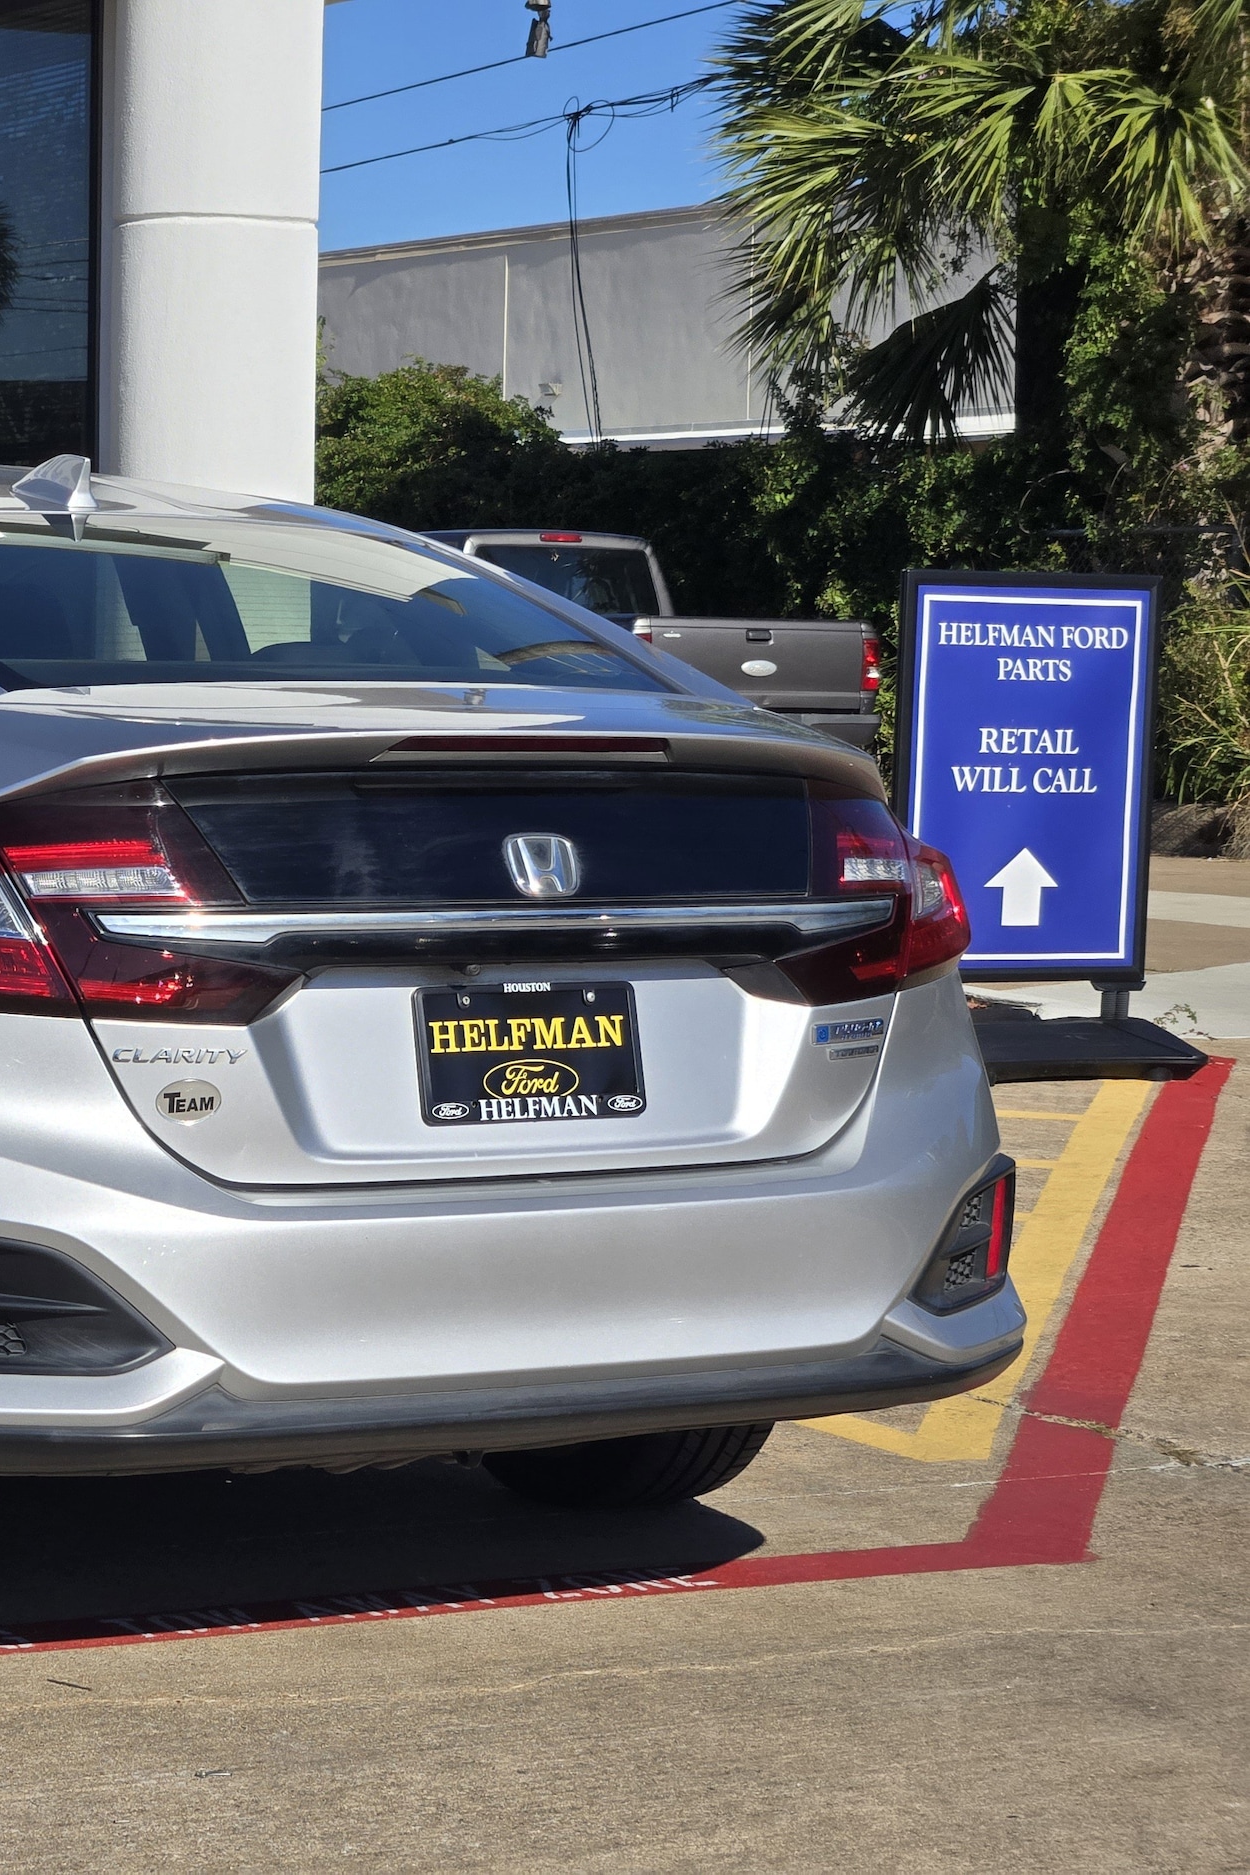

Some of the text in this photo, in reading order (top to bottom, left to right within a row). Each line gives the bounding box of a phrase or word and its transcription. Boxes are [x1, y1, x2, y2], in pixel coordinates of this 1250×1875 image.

[938, 622, 1129, 650] HELFMAN FORD
[996, 657, 1072, 682] PARTS
[978, 727, 1080, 755] RETAIL
[951, 766, 1097, 794] WILL CALL
[503, 982, 551, 993] HOUSTON
[428, 1015, 624, 1054] HELFMAN
[111, 1047, 248, 1065] CLARITY
[501, 1064, 560, 1095] Ford
[478, 1094, 598, 1121] HELFMAN
